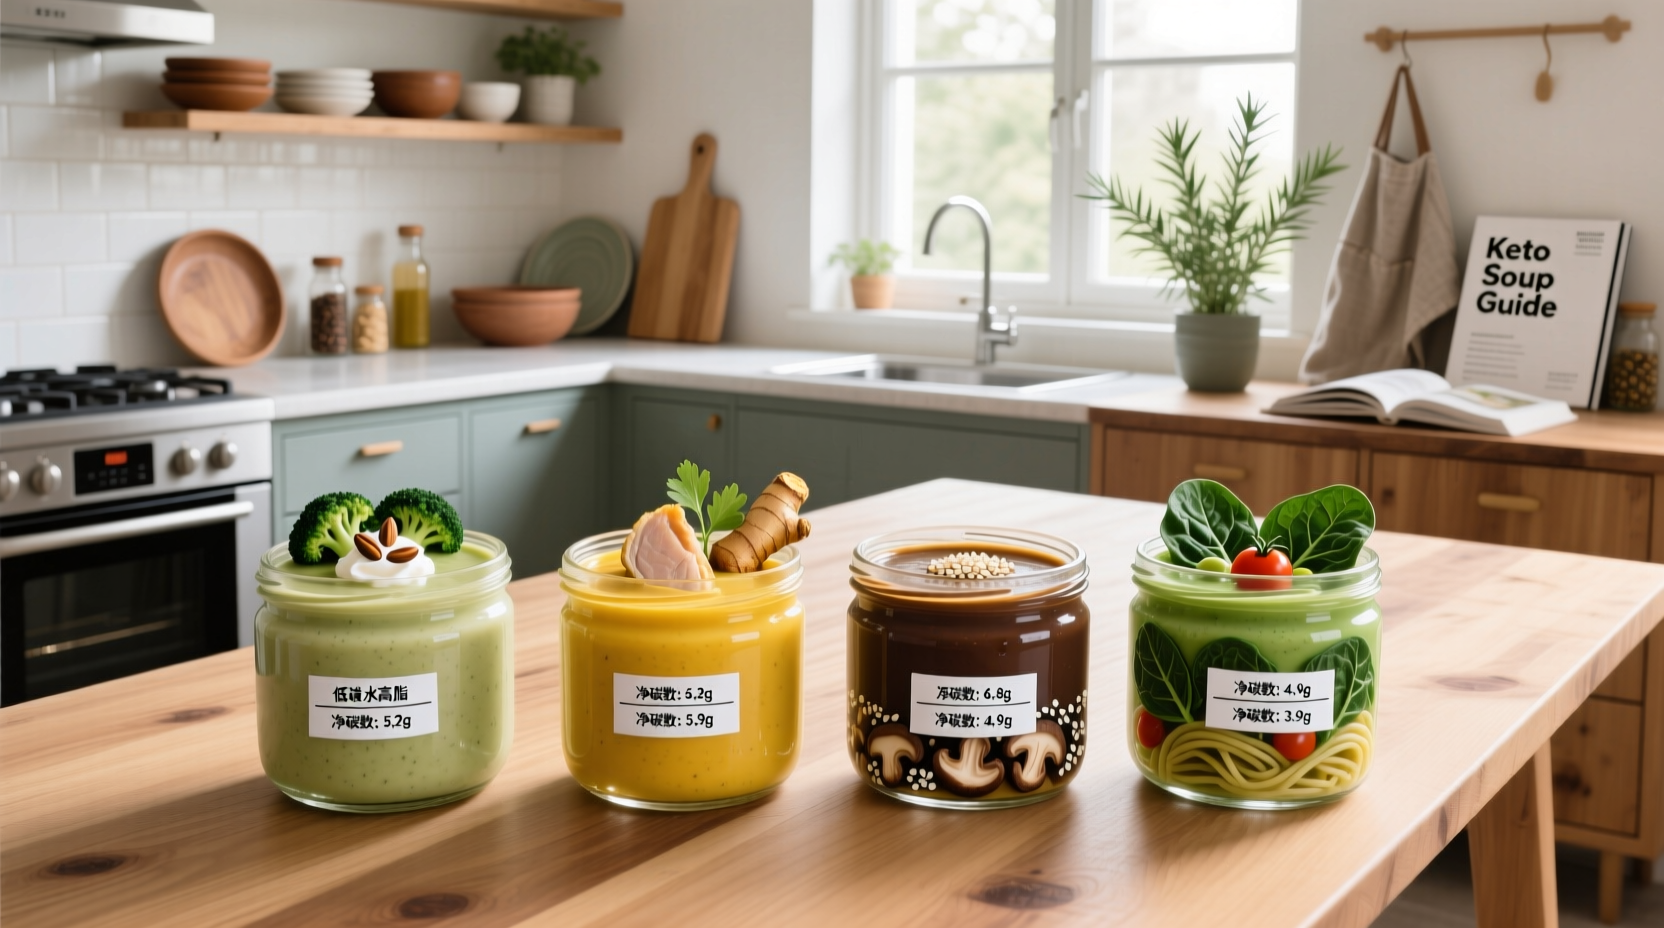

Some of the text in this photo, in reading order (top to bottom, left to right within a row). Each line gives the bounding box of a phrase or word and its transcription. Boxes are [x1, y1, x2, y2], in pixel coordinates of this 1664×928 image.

[1486, 236, 1551, 262] Keto
[1482, 263, 1554, 292] Soup
[1476, 290, 1557, 318] Guide
